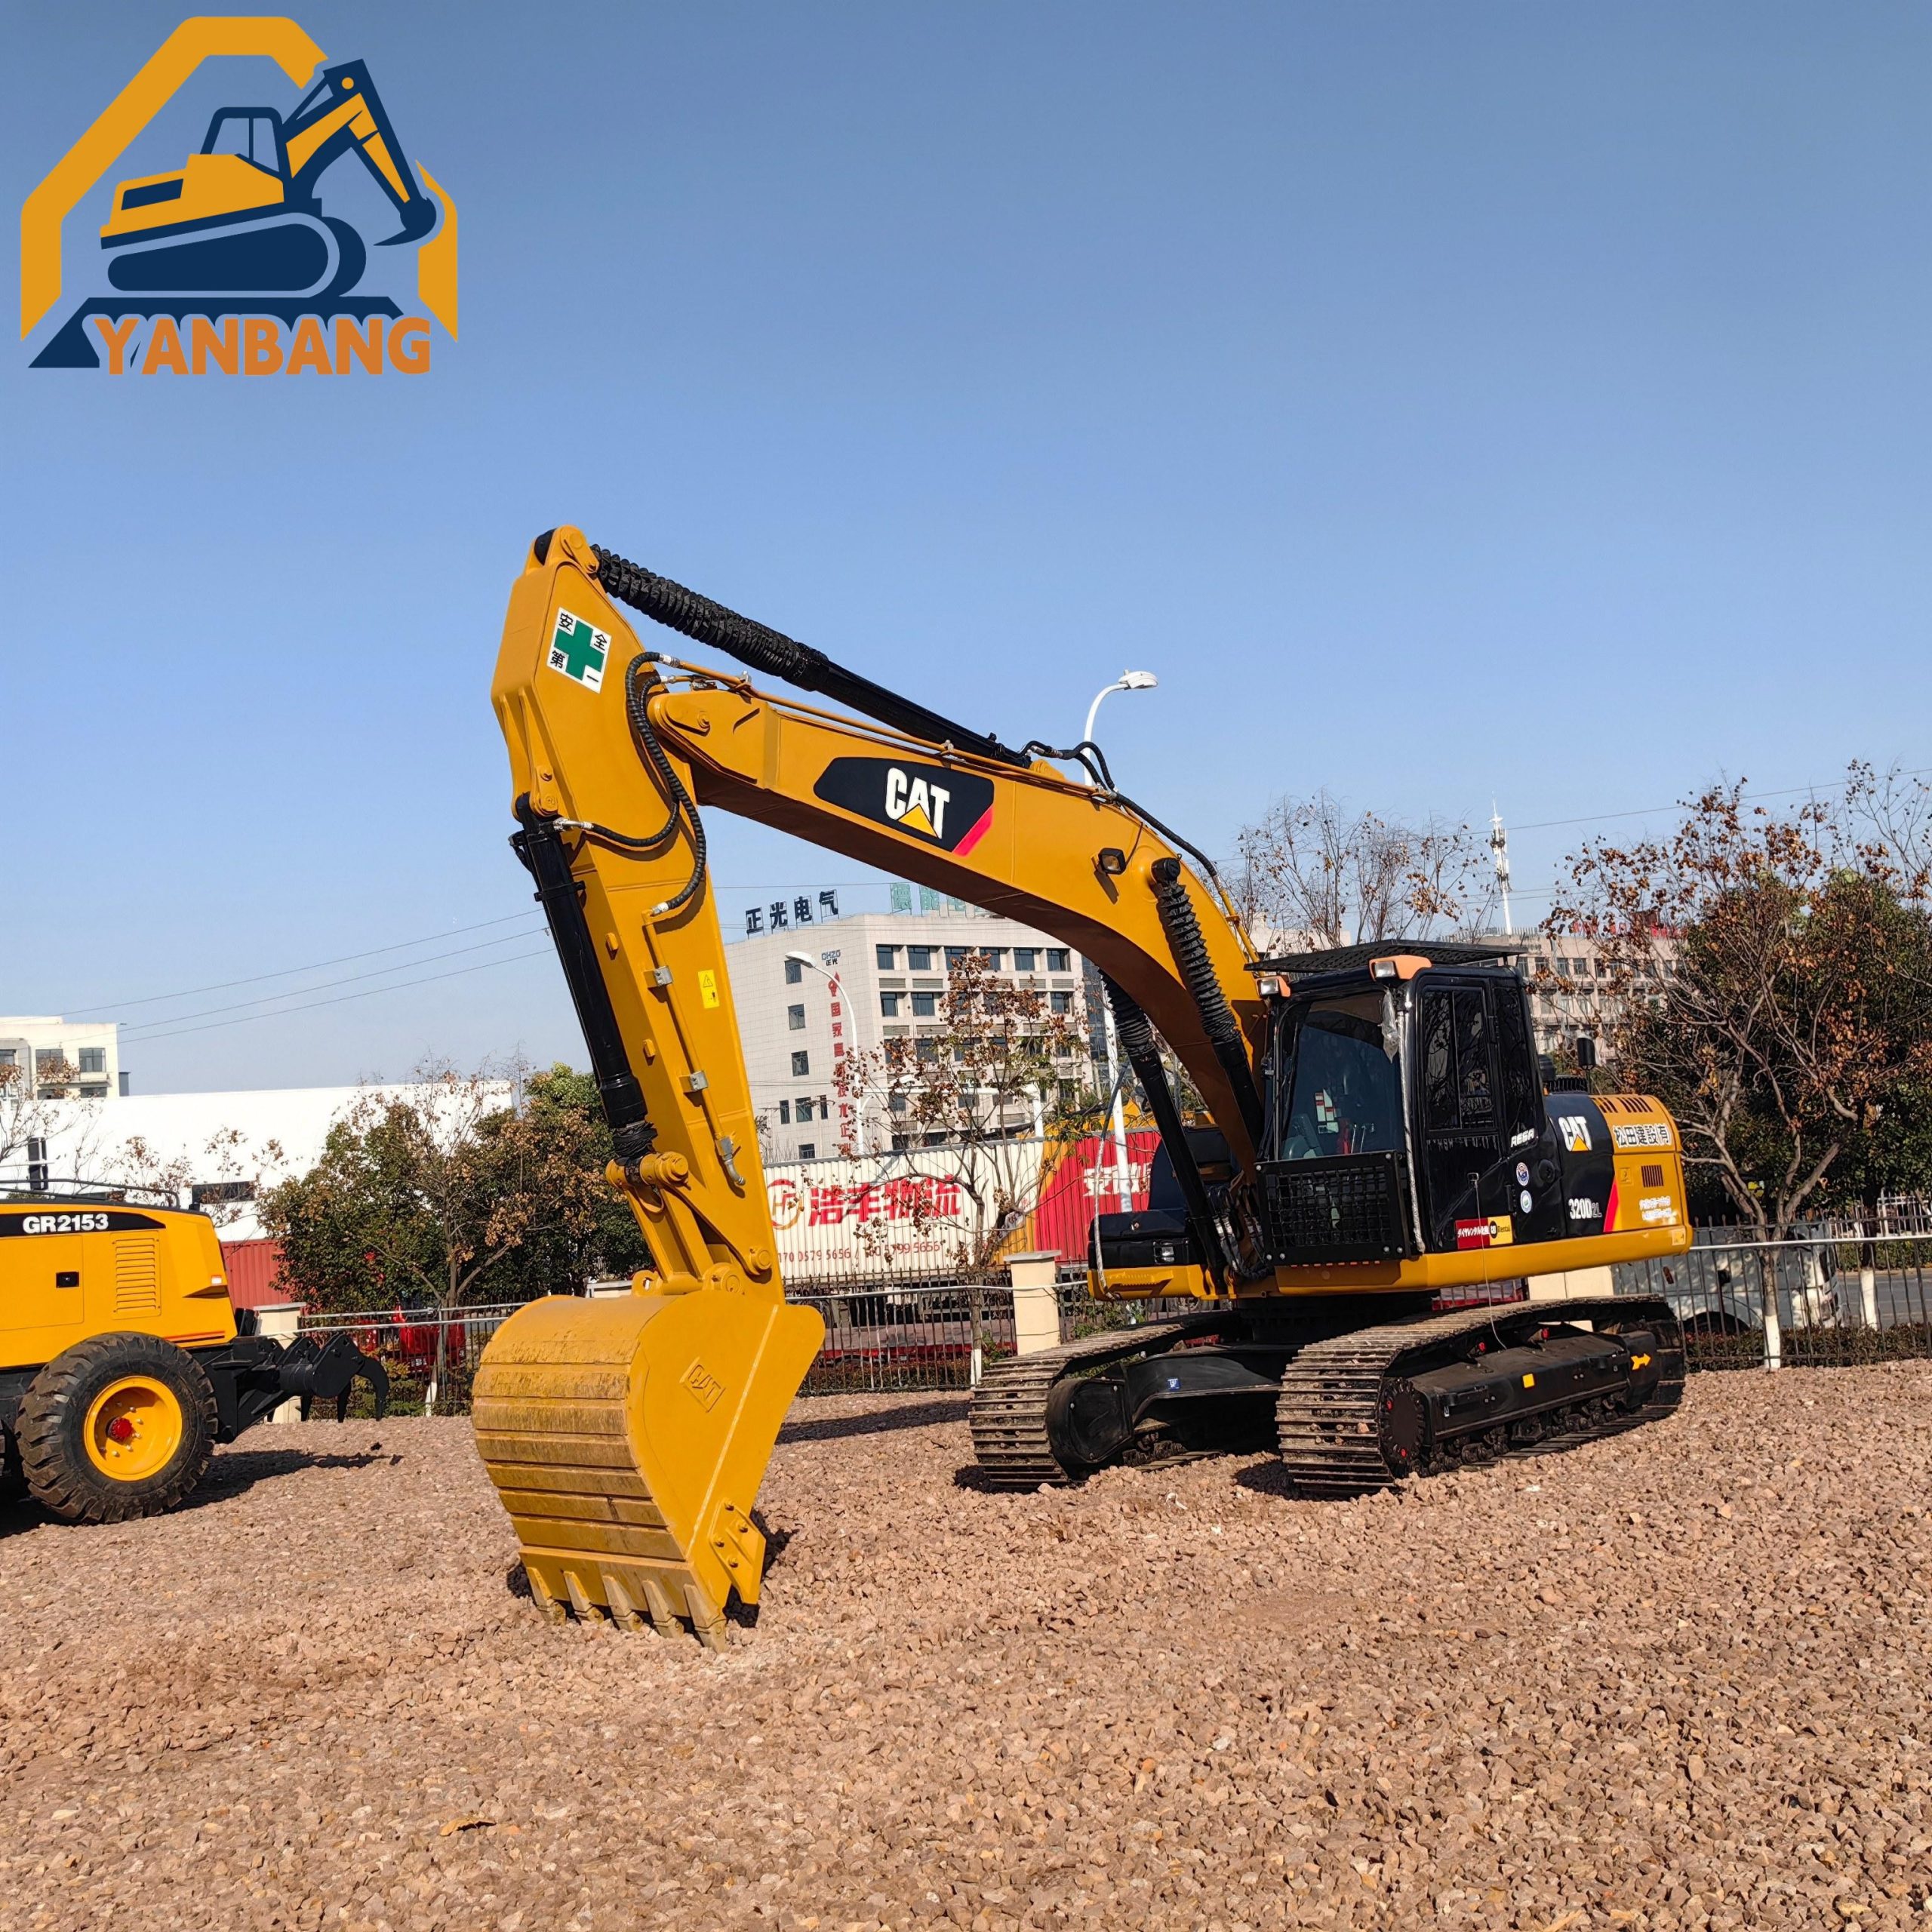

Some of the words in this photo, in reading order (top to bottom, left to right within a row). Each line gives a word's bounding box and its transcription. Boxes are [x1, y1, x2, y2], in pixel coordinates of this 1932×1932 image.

[885, 767, 951, 839] CAT
[746, 889, 838, 934] 正光电气
[1558, 1116, 1592, 1152] CAT
[23, 1213, 109, 1234] GR2153
[798, 1249, 822, 1262] 0579
[826, 1247, 851, 1260] 5656
[913, 1240, 940, 1254] 5656
